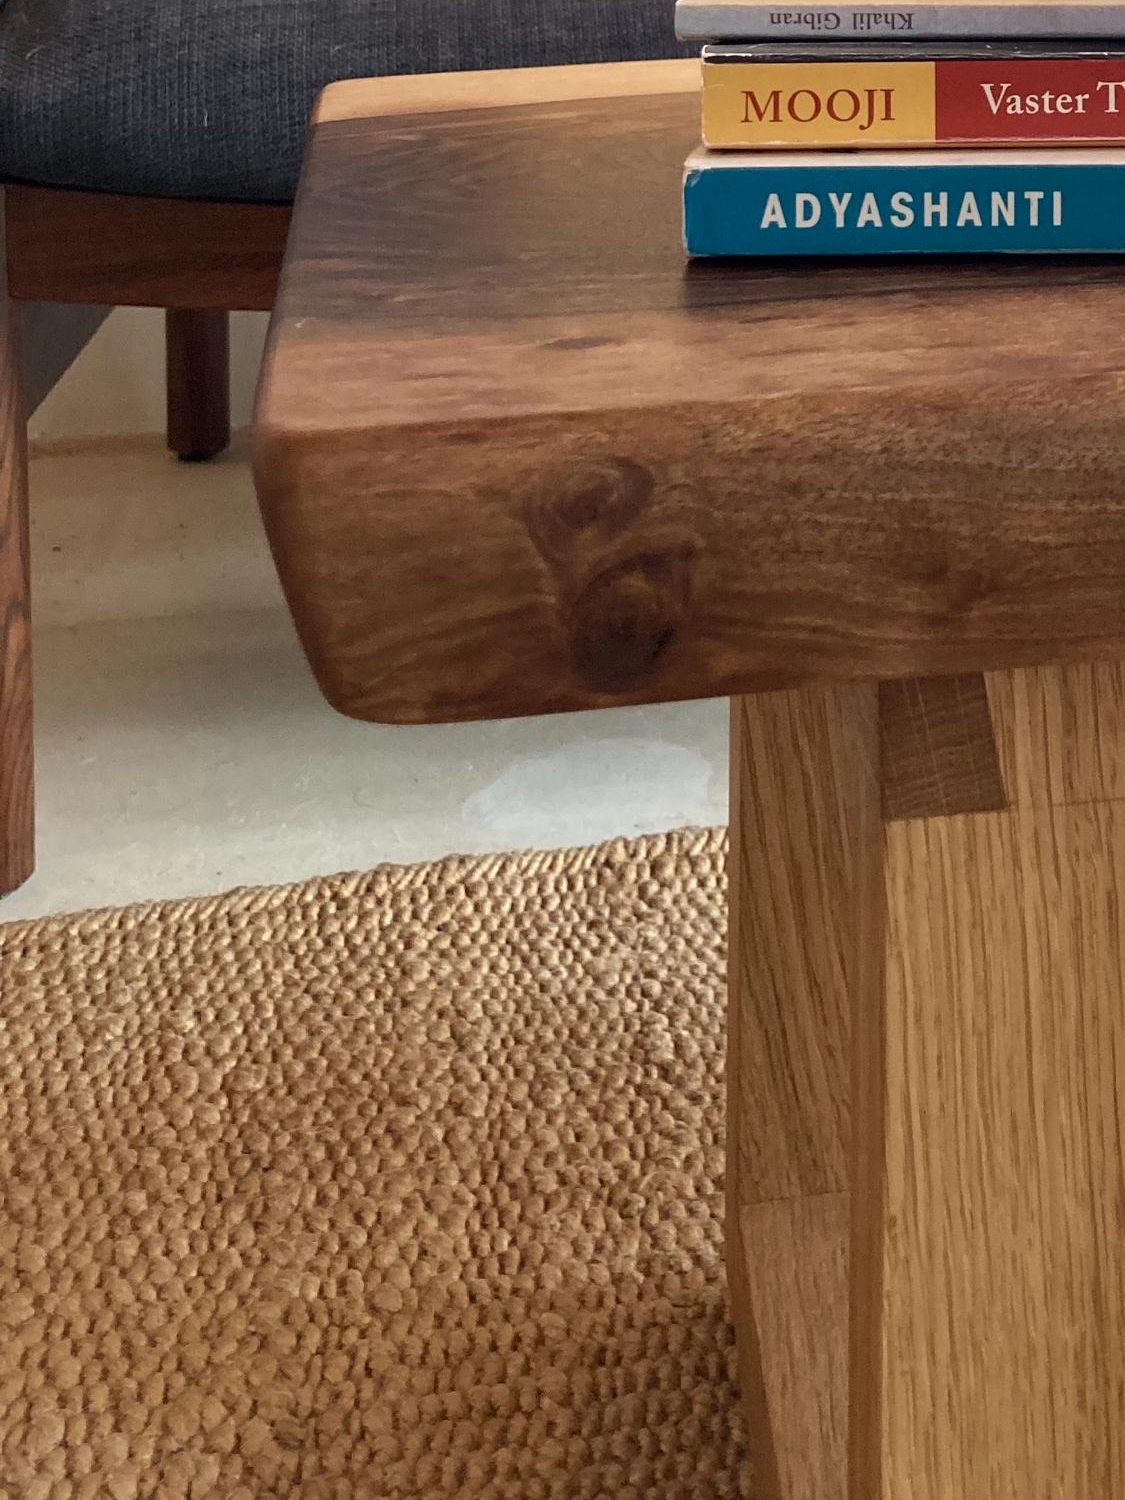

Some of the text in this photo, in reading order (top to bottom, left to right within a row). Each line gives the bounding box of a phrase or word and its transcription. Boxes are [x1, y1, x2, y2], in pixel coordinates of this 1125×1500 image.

[769, 12, 915, 30] Khalil Gibran
[740, 87, 896, 130] MOOJI
[980, 83, 1090, 115] Vaster
[759, 190, 1063, 229] ADYASHANTI
